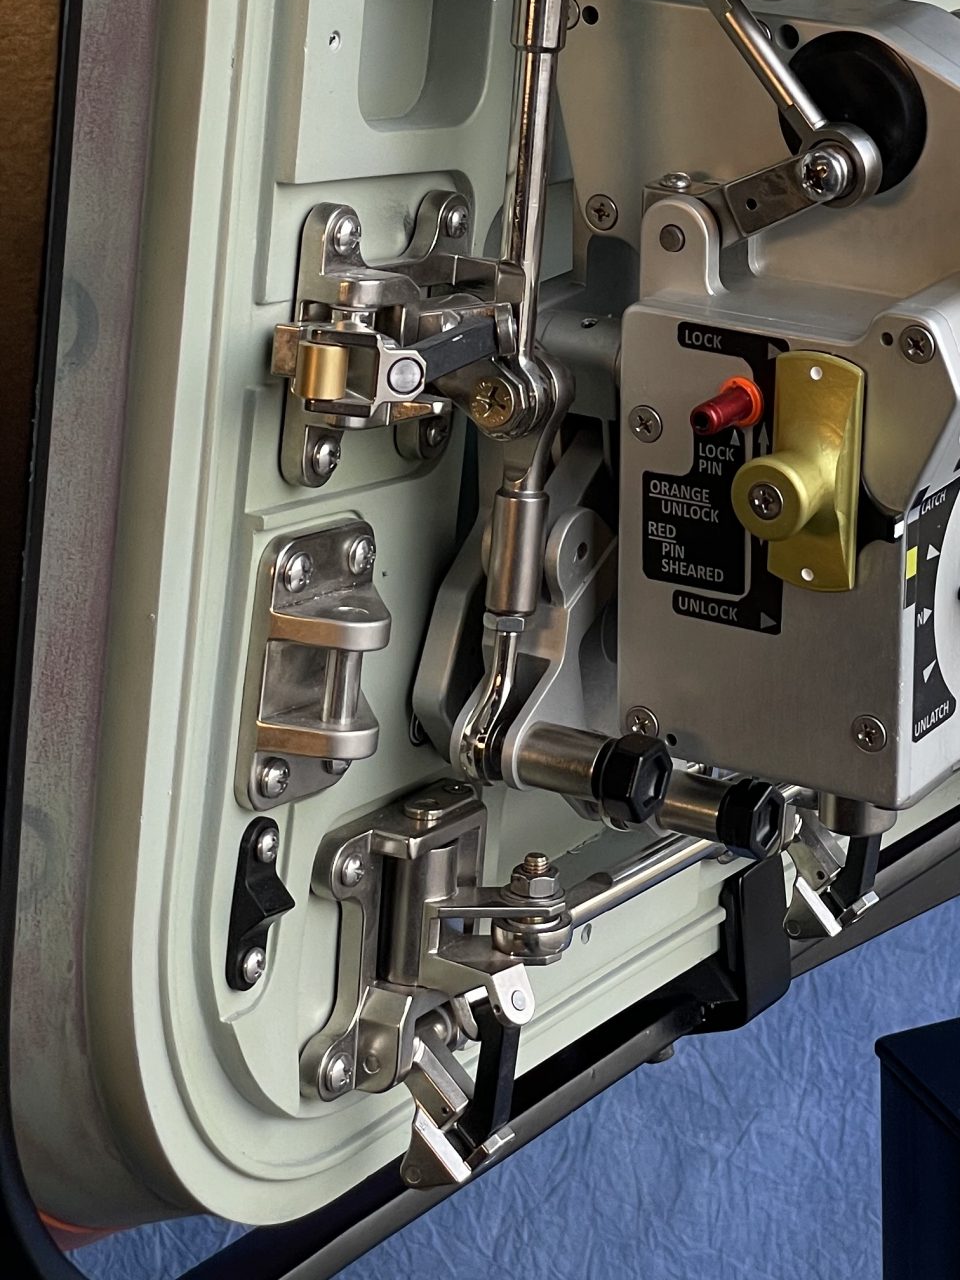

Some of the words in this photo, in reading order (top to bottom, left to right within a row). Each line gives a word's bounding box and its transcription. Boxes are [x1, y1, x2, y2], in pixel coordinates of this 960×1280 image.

[685, 329, 723, 350] LOCK
[698, 442, 735, 462] LOCK
[698, 458, 723, 477] PIN
[649, 479, 711, 504] ORANGE
[921, 489, 947, 516] LATCH
[661, 499, 720, 524] UNLOCK
[648, 521, 677, 539] RED
[661, 542, 685, 559] PIN
[660, 558, 725, 583] SHEARED
[678, 595, 739, 622] UNLOCK
[914, 700, 950, 737] UNLATCH
